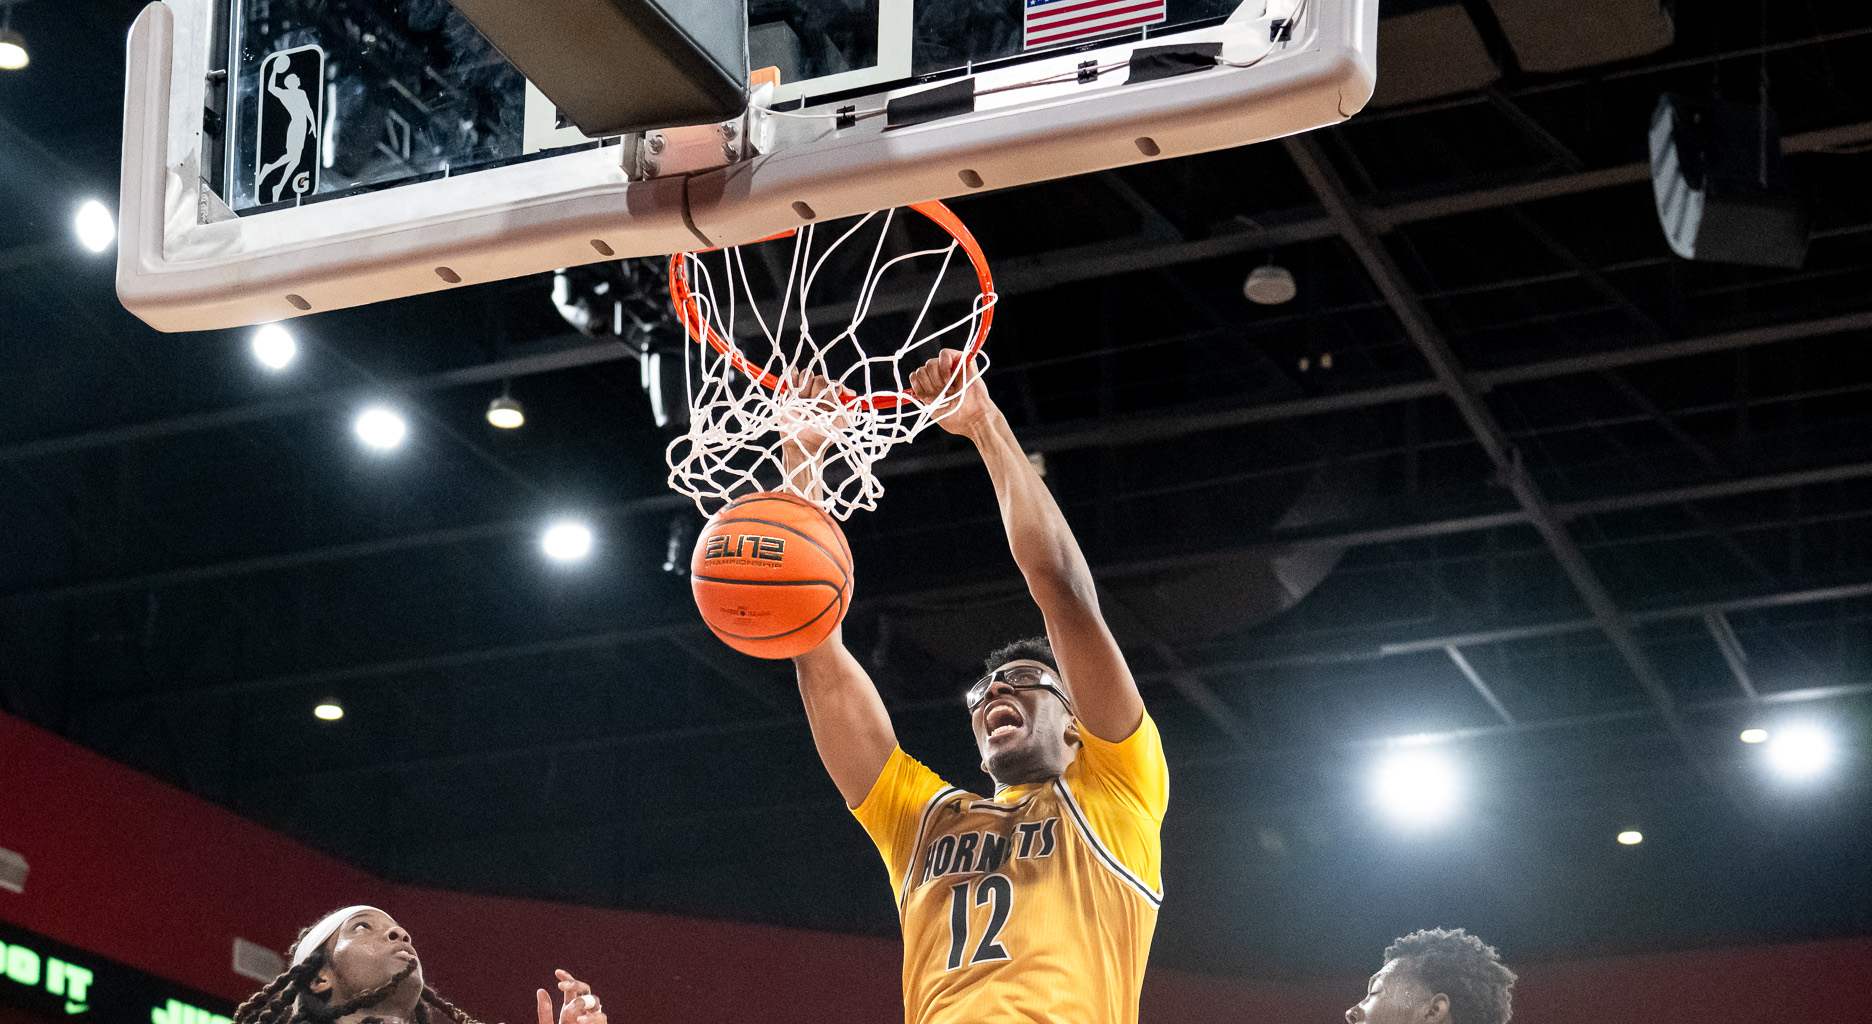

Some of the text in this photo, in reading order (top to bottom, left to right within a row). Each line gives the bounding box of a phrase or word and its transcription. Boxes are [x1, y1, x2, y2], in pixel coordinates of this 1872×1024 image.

[292, 171, 310, 193] G
[706, 534, 786, 563] ELITE
[946, 873, 1014, 972] 12
[0, 940, 94, 1002] O IT
